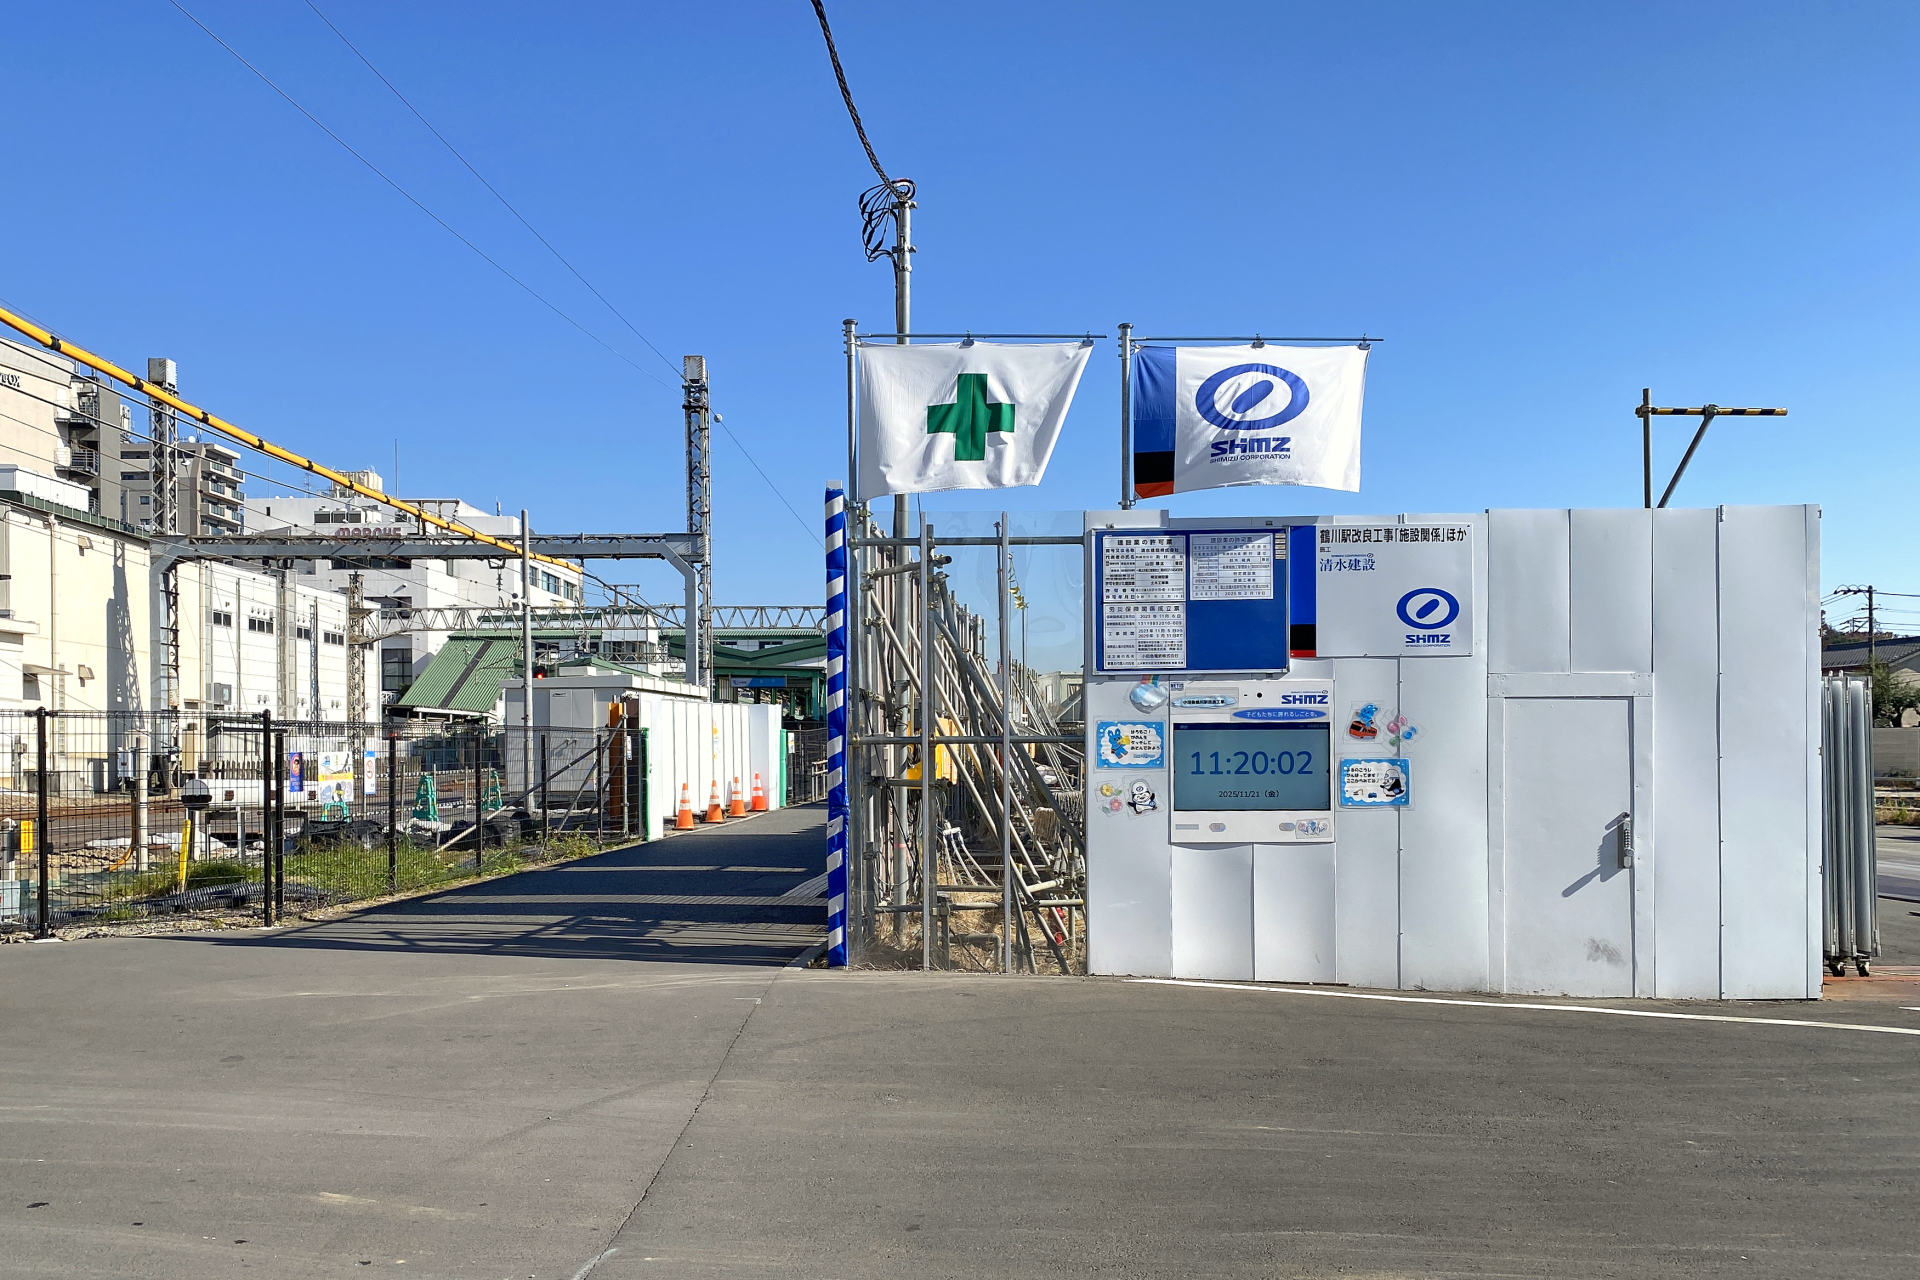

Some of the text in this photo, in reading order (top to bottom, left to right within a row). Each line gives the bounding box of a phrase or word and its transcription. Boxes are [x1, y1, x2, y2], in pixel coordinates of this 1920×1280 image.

[1210, 453, 1291, 464] SHIMIZU CORPORATION
[1117, 538, 1173, 546] 建設業の許可票
[1210, 536, 1253, 544] 建設業の許可票
[1319, 558, 1376, 572] 清水建設
[1108, 605, 1180, 613] 労災保険関係成立票
[1190, 751, 1313, 775] 11:20:02
